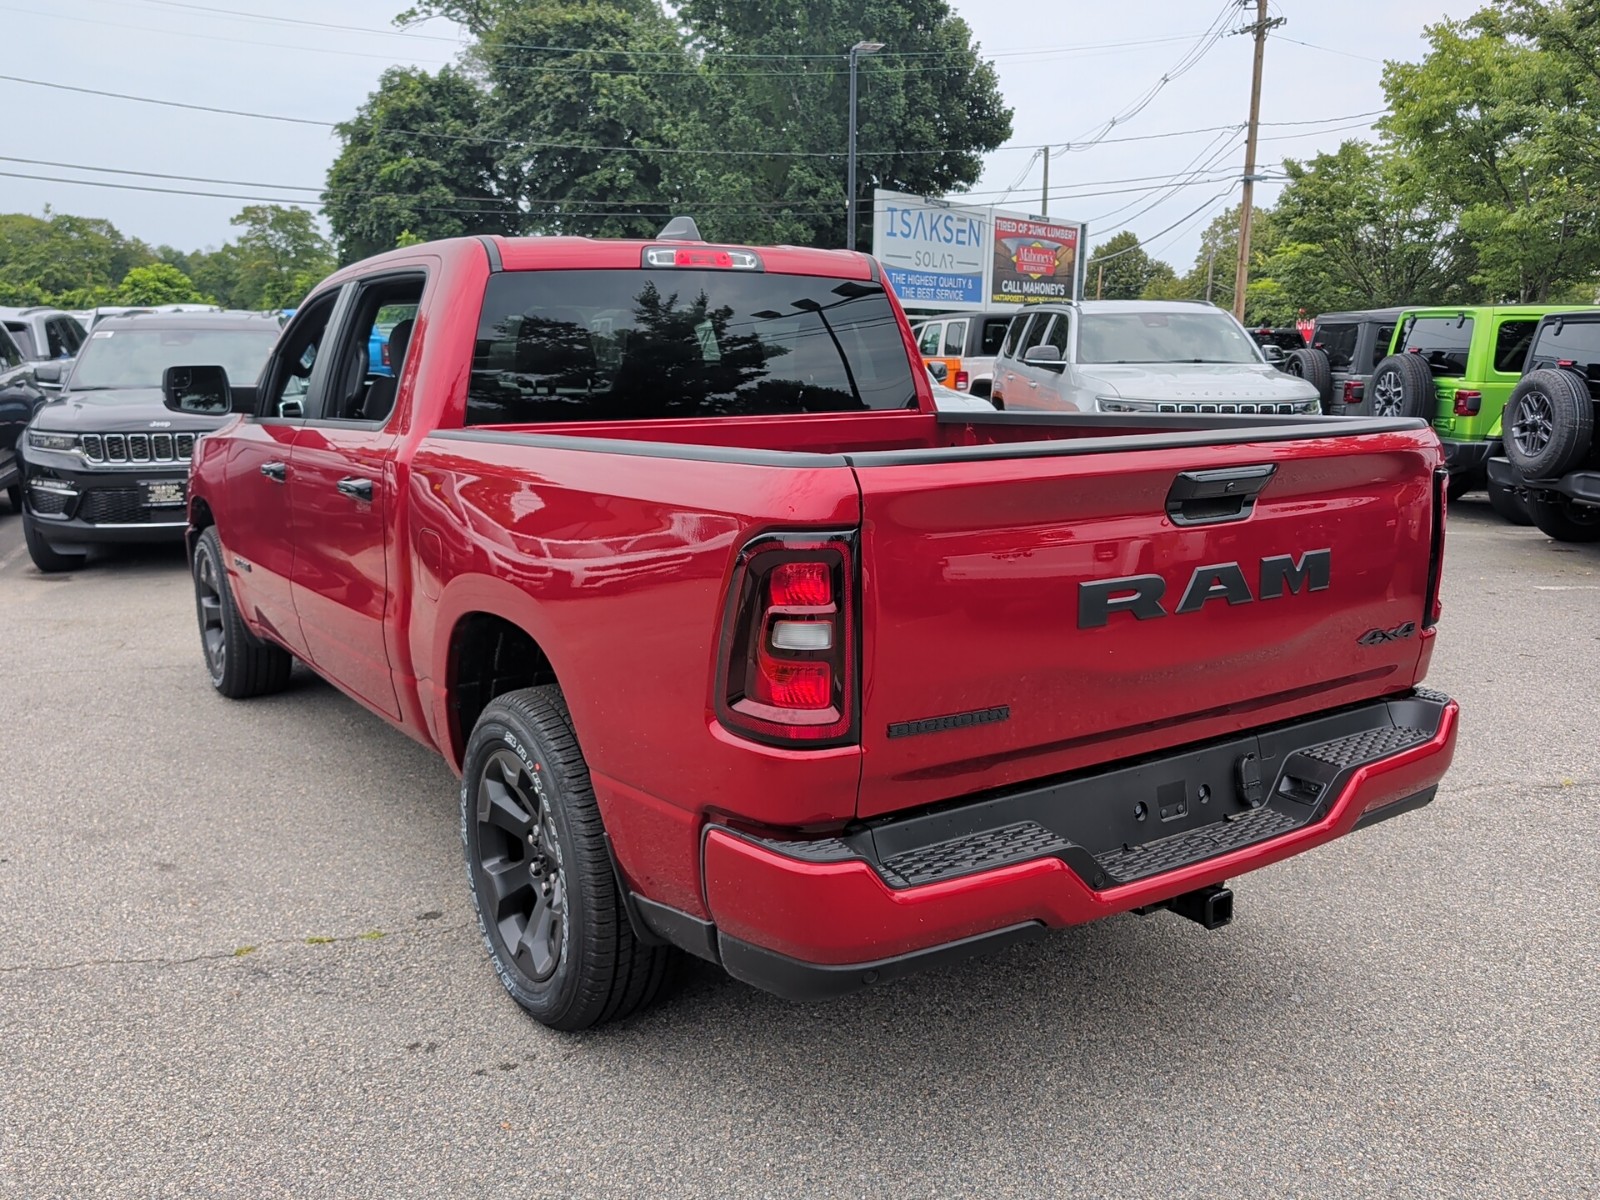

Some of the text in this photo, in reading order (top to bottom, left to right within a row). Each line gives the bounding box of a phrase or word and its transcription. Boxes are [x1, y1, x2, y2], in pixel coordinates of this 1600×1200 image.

[886, 206, 981, 248] ISAKSEN
[996, 219, 1076, 241] TIRED OF JUNK LUMBER?
[914, 250, 954, 269] SOLAR
[891, 272, 973, 289] THE HIGHEST QUALITY &
[1001, 280, 1065, 295] CALL MAHONEY'S
[901, 287, 964, 301] THE BEST SERVICE
[1078, 548, 1331, 629] RAM
[1357, 622, 1415, 646] 4x4
